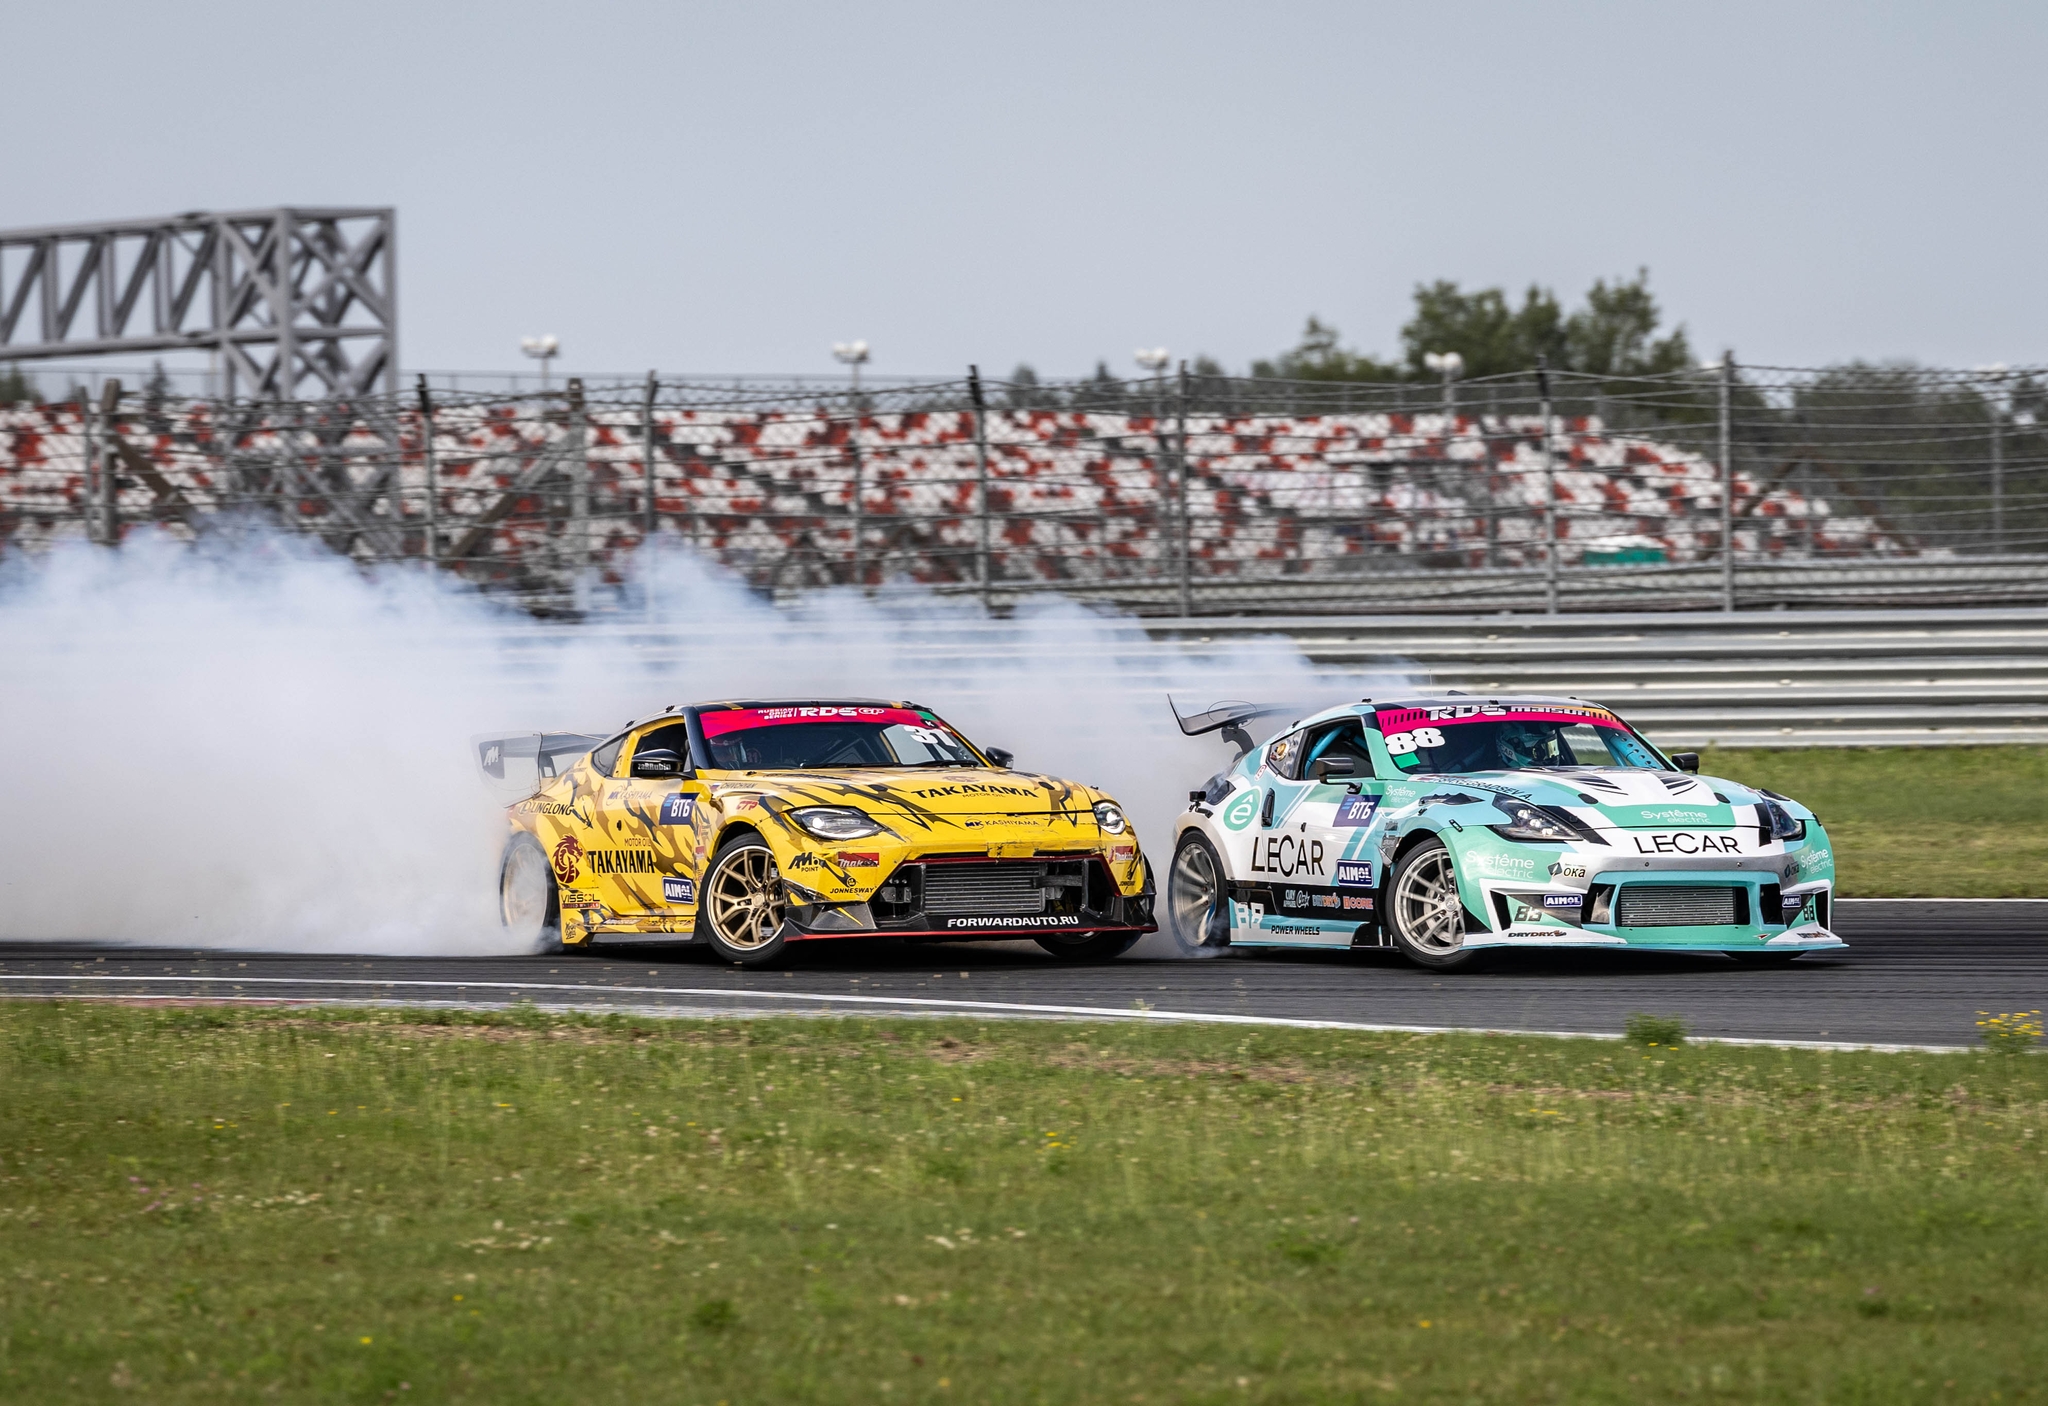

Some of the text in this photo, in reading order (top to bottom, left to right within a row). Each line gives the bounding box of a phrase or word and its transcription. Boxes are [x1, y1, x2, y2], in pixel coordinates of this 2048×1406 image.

[799, 707, 858, 717] RDS
[1428, 704, 1506, 721] RDS
[903, 725, 958, 748] 31
[1384, 727, 1445, 755] 88
[911, 784, 1039, 799] TAKAYAMA
[1385, 785, 1416, 797] Systême
[530, 802, 574, 815] LINGLONG
[1640, 809, 1708, 820] Systême
[1667, 816, 1712, 824] electric
[624, 838, 642, 847] MOTOR
[1633, 832, 1743, 854] LECAR
[588, 850, 655, 874] TAKAYAMA
[1251, 834, 1325, 877] LECAR
[1466, 850, 1535, 869] Systême
[1801, 848, 1829, 869] Systême
[1338, 866, 1371, 882] AIMOL
[1810, 859, 1833, 874] electric
[665, 882, 692, 898] AIMOL
[561, 893, 600, 903] VISSOL
[1546, 896, 1579, 905] AIMOL
[1803, 905, 1815, 921] 88
[947, 915, 1079, 928] FORWARDAUTO.RU
[1271, 925, 1320, 935] POWER WHEELS
